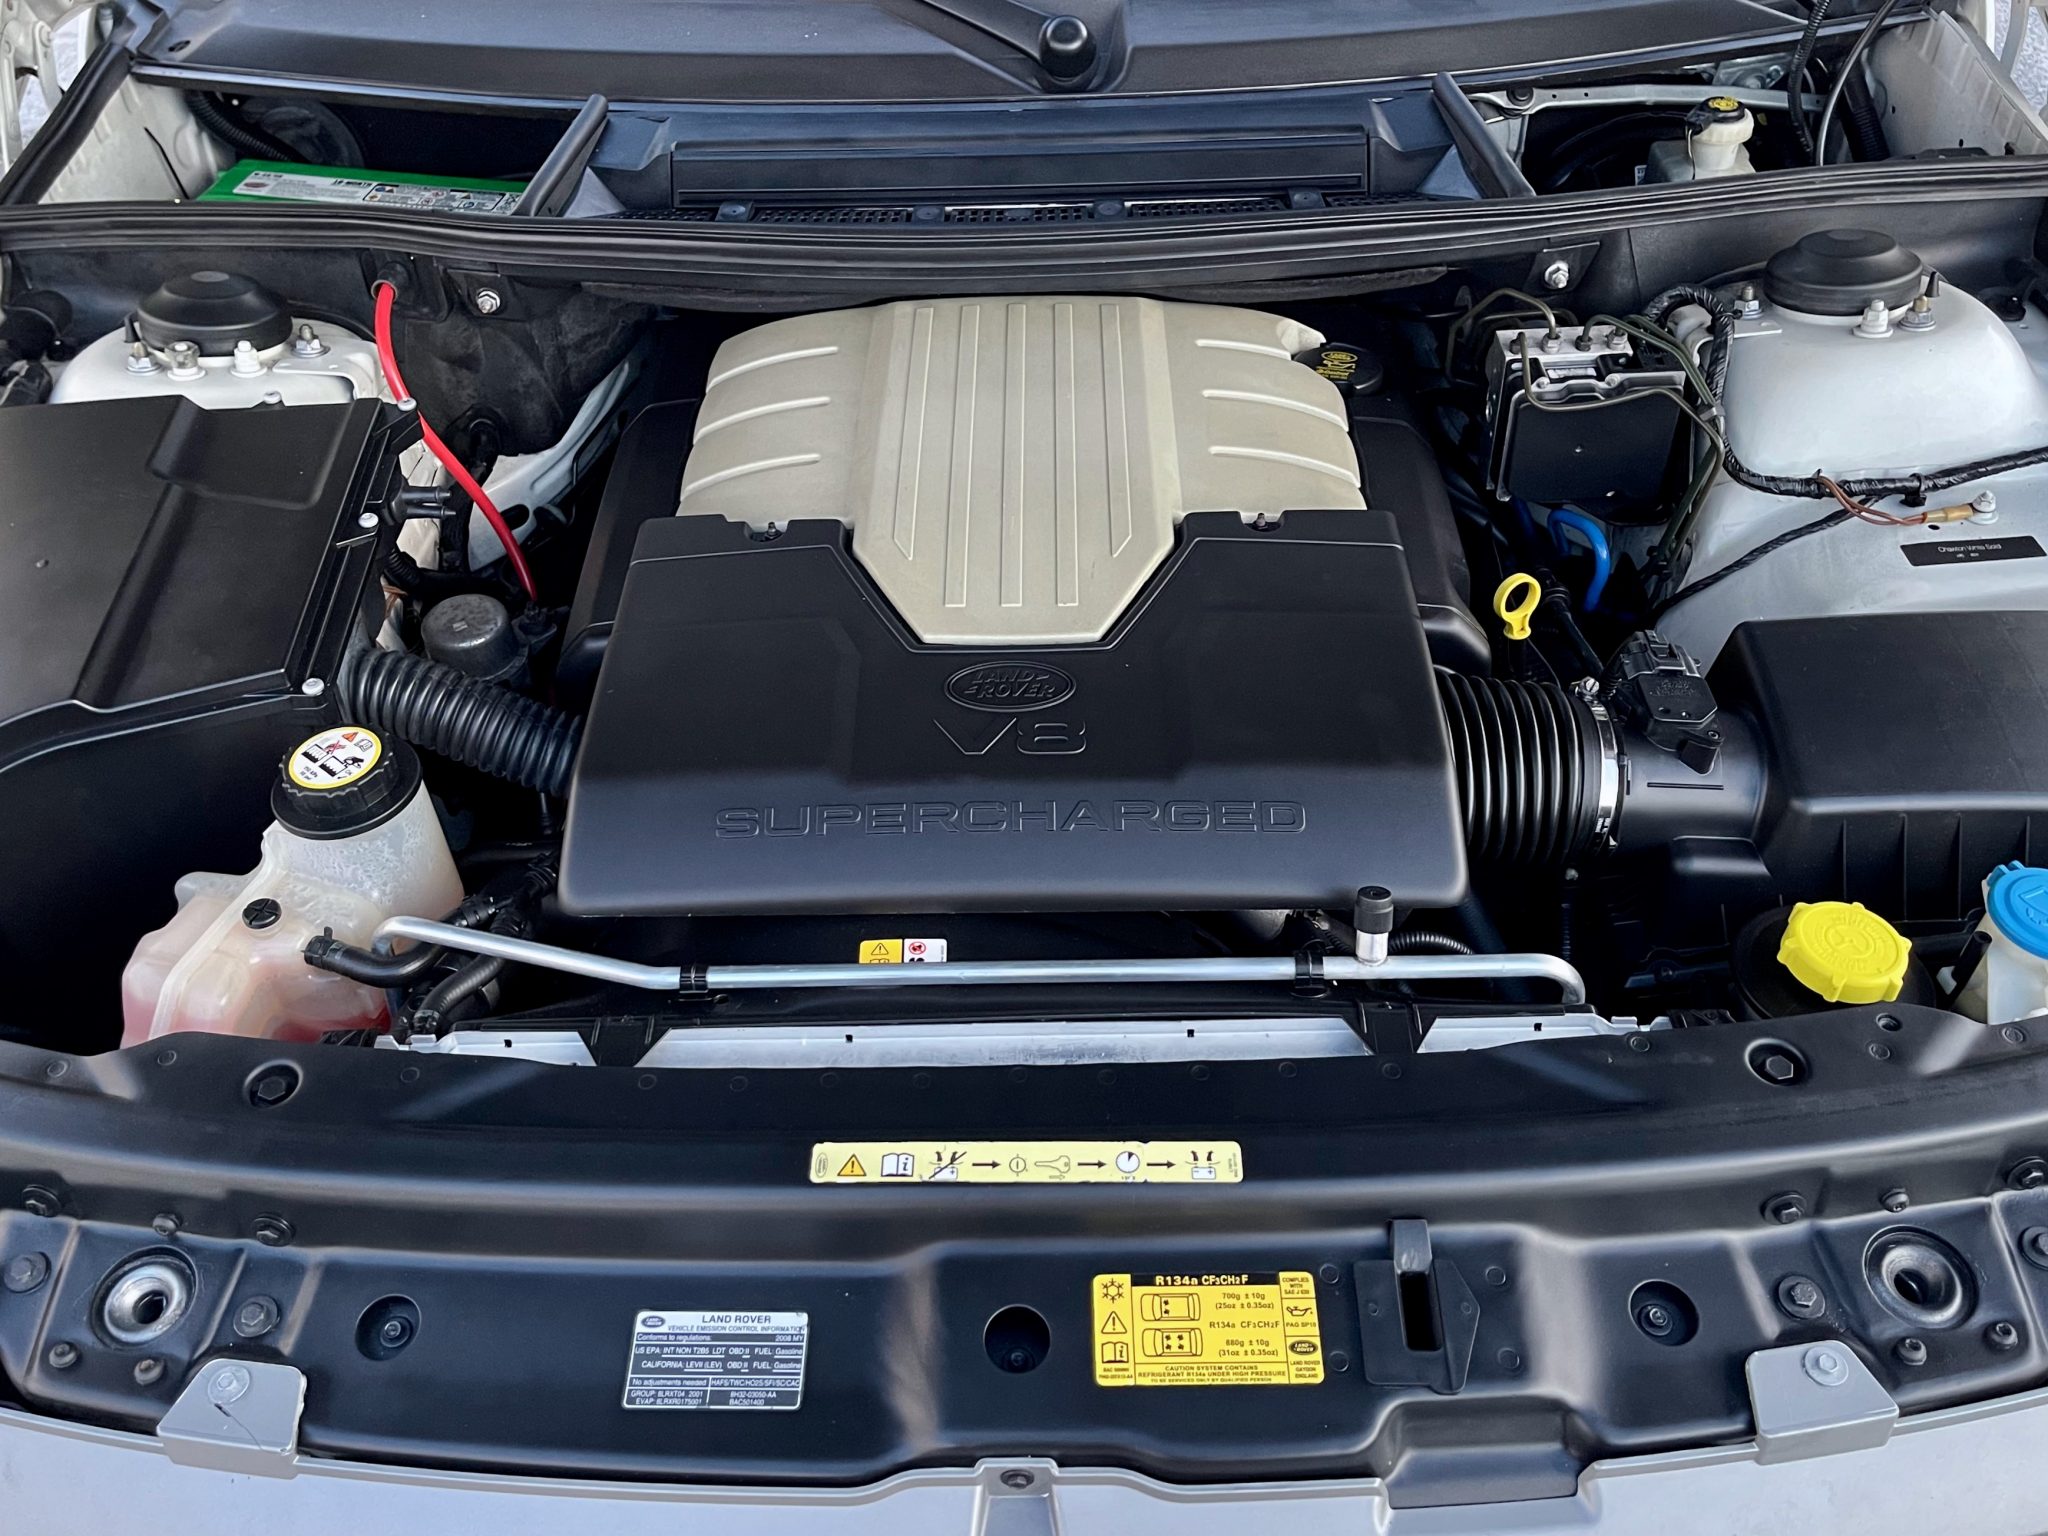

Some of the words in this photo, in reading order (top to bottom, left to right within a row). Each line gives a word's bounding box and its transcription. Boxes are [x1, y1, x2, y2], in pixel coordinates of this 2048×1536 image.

[971, 669, 1035, 684] LAND
[976, 682, 1056, 698] ROVER
[933, 717, 1087, 755] V8
[714, 801, 1307, 840] SUPERCHARGED
[1155, 1275, 1199, 1286] R134a
[1222, 1292, 1241, 1301] 700g
[1252, 1292, 1266, 1301] 10g
[1215, 1302, 1236, 1310] (25oz
[1246, 1302, 1275, 1310] 0.35oz)
[701, 1314, 732, 1324] LAND
[734, 1315, 772, 1324] ROVER
[1209, 1321, 1236, 1329] R134a
[637, 1333, 668, 1341] Conforms
[1255, 1339, 1270, 1347] 10g
[635, 1346, 645, 1354] US
[712, 1347, 726, 1355] LDT
[775, 1347, 803, 1355] Gasoline
[1218, 1349, 1240, 1357] (31oz
[1250, 1349, 1279, 1357] 0.35oz)
[773, 1361, 802, 1370] Gasoline
[632, 1378, 642, 1386] No
[643, 1379, 682, 1387] adjustments
